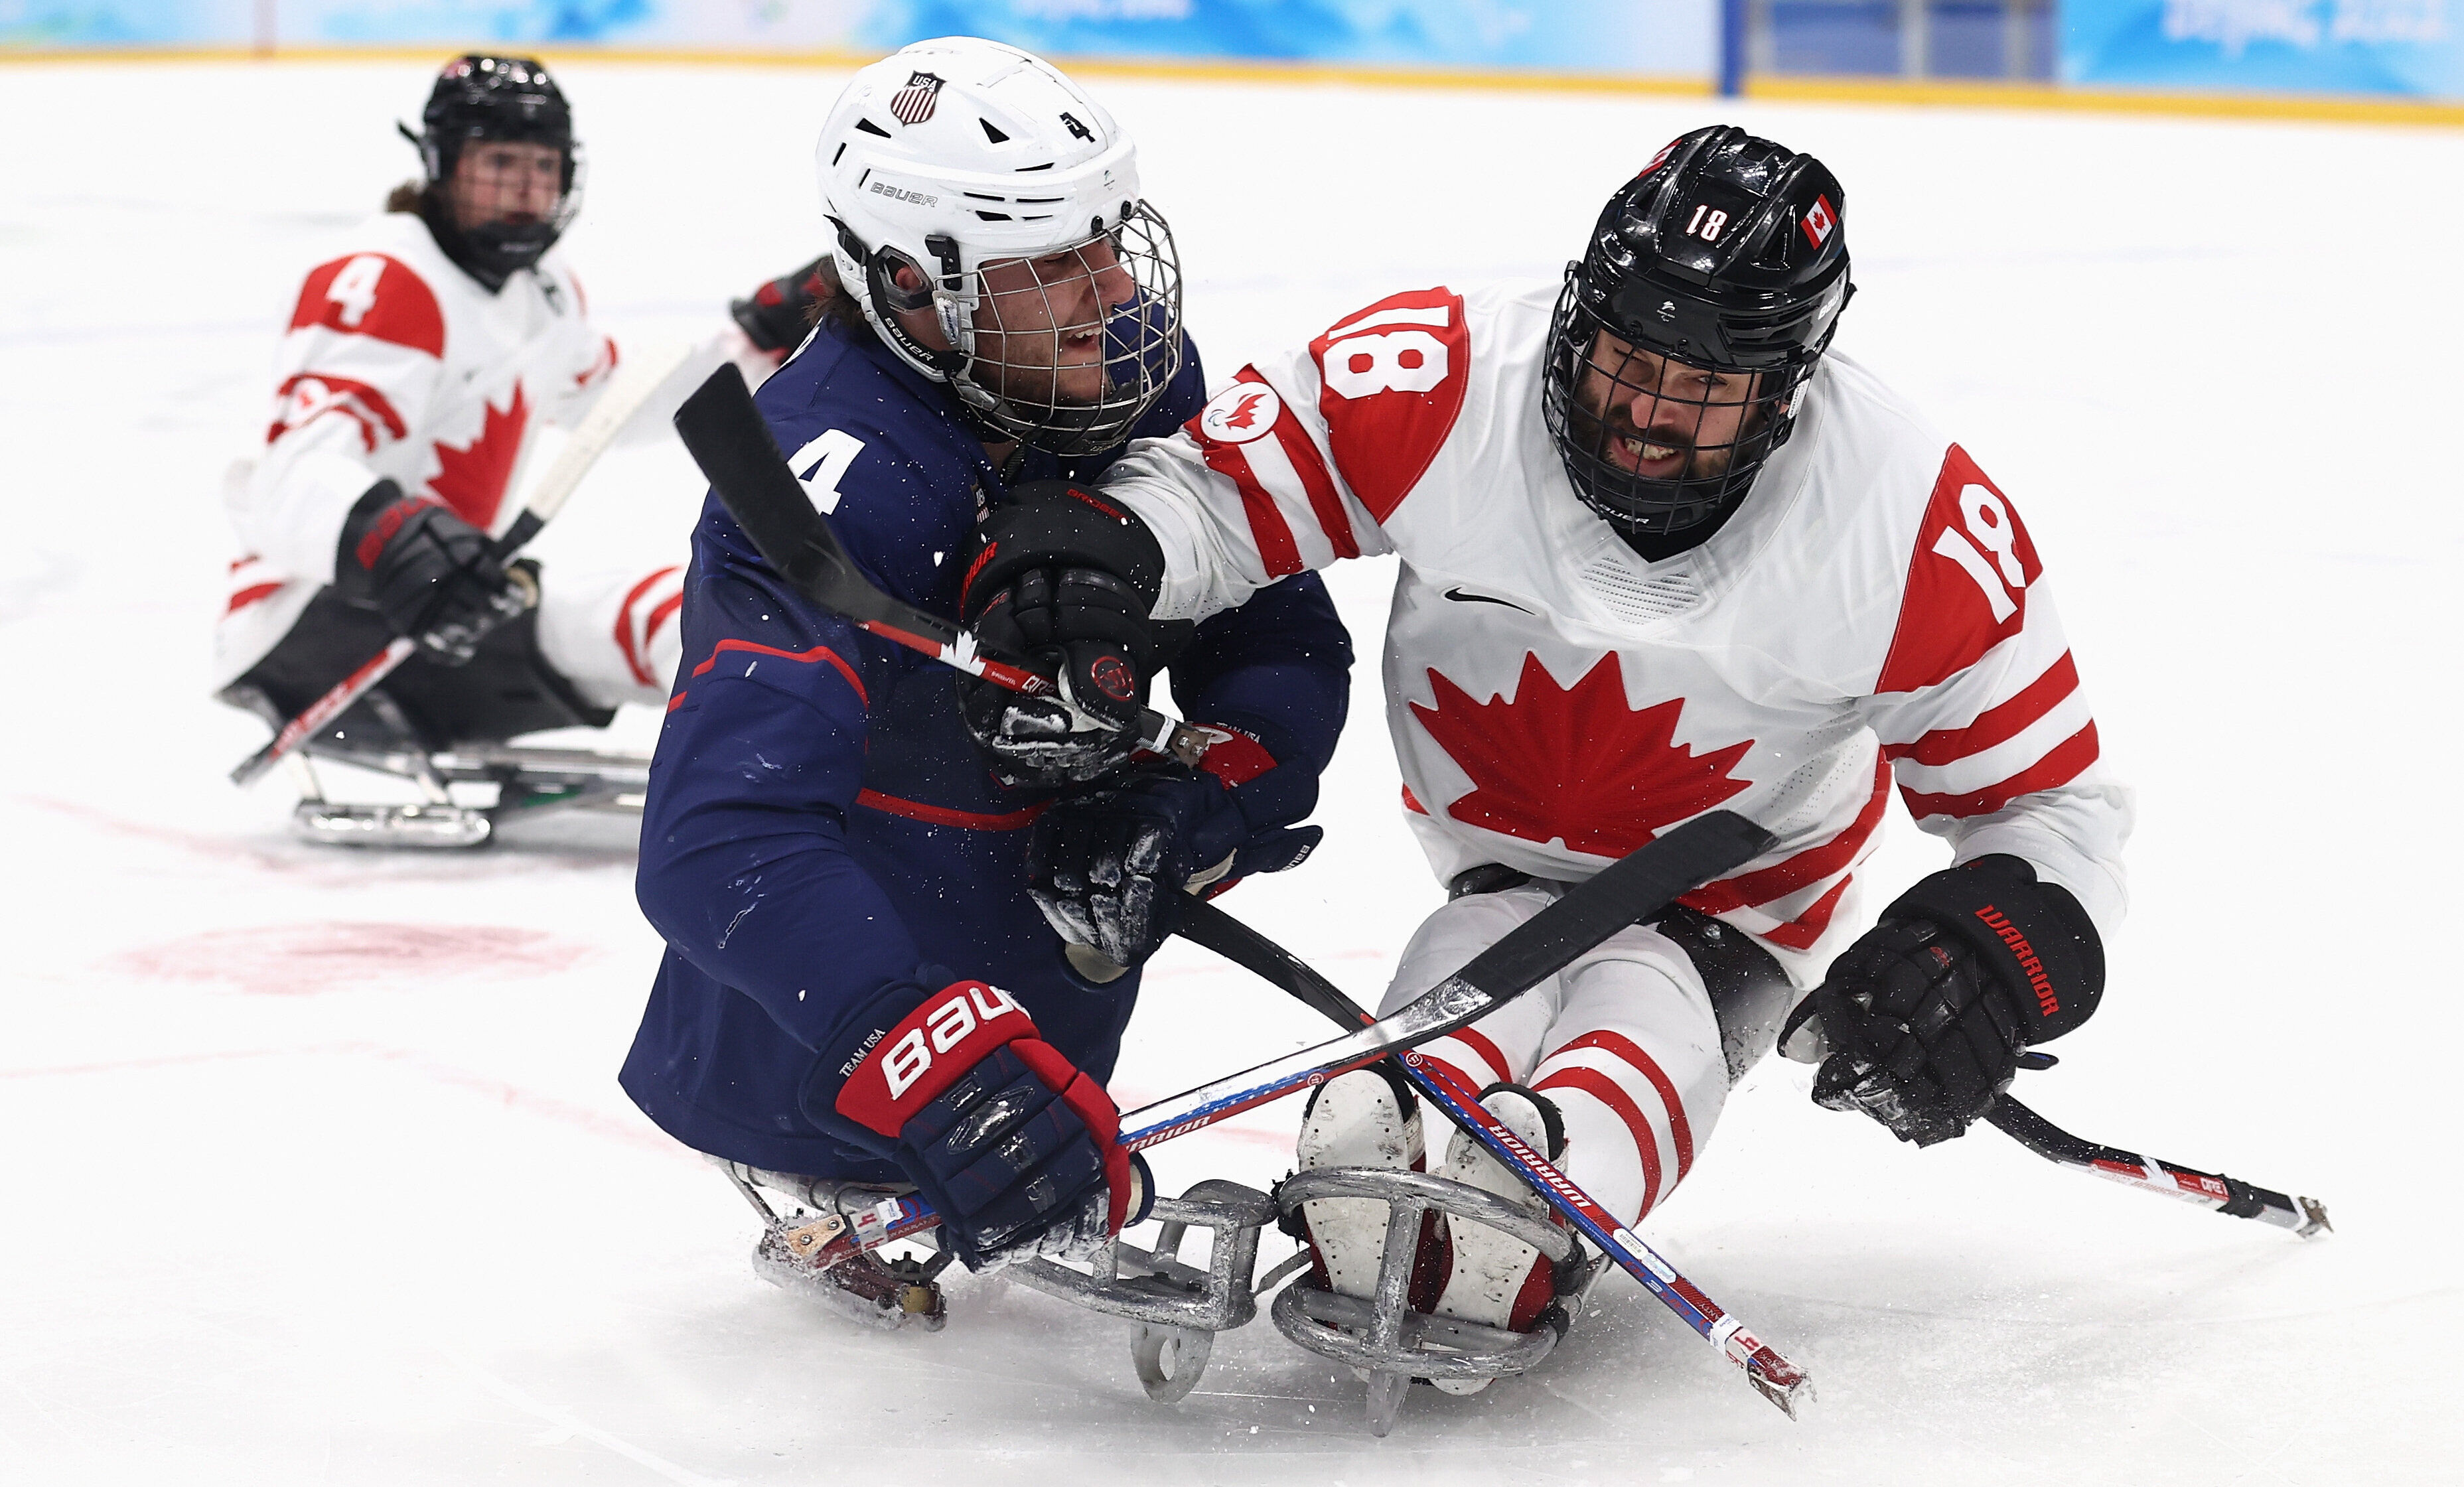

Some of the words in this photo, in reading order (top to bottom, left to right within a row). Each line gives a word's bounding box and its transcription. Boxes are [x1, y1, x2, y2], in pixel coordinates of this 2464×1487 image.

[912, 75, 937, 92] USA
[1059, 111, 1096, 143] 4
[871, 182, 938, 208] BAUER
[1686, 204, 1729, 242] 18
[325, 255, 386, 326] 4
[885, 317, 934, 361] BAUER
[1323, 305, 1449, 399] 18
[787, 429, 865, 516] 4
[1599, 504, 1650, 524] AUER
[1974, 904, 2060, 1017] WARRIOR
[838, 1048, 867, 1079] TEAM
[865, 1027, 886, 1050] USA
[880, 985, 1032, 1101] BAU
[1126, 1115, 1211, 1153] ARRIOR
[1489, 1123, 1591, 1208] WARRIOR
